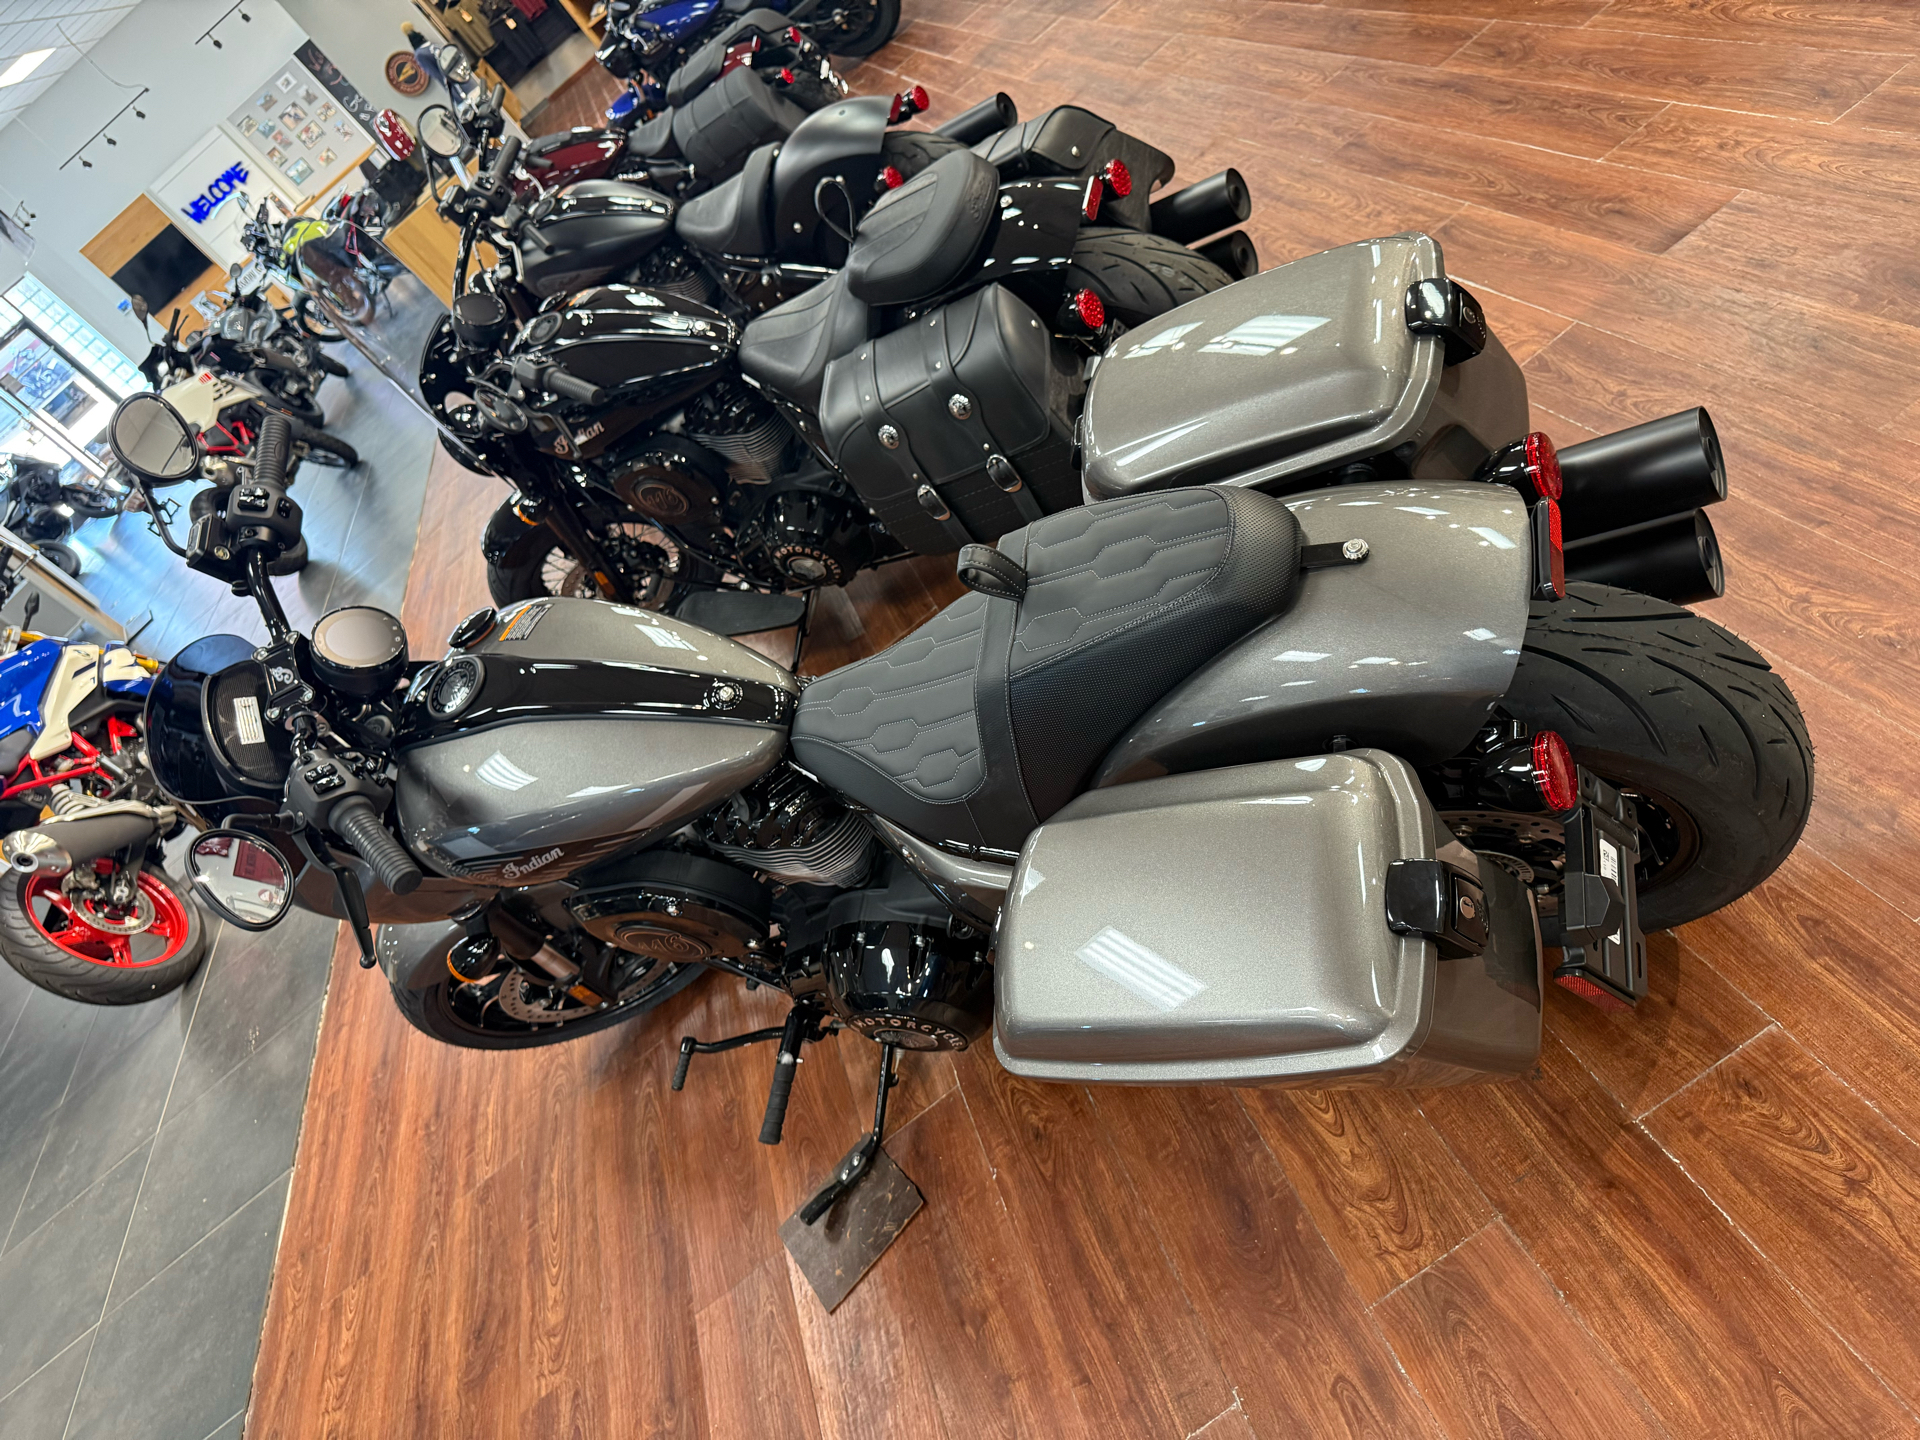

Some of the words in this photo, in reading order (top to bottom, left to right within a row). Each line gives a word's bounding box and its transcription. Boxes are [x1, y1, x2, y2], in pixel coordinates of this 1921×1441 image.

[182, 162, 250, 224] WELCOME
[774, 545, 842, 575] MOTORCYCLE
[502, 847, 565, 879] Indian
[853, 1016, 964, 1050] MOTORCYCLE
